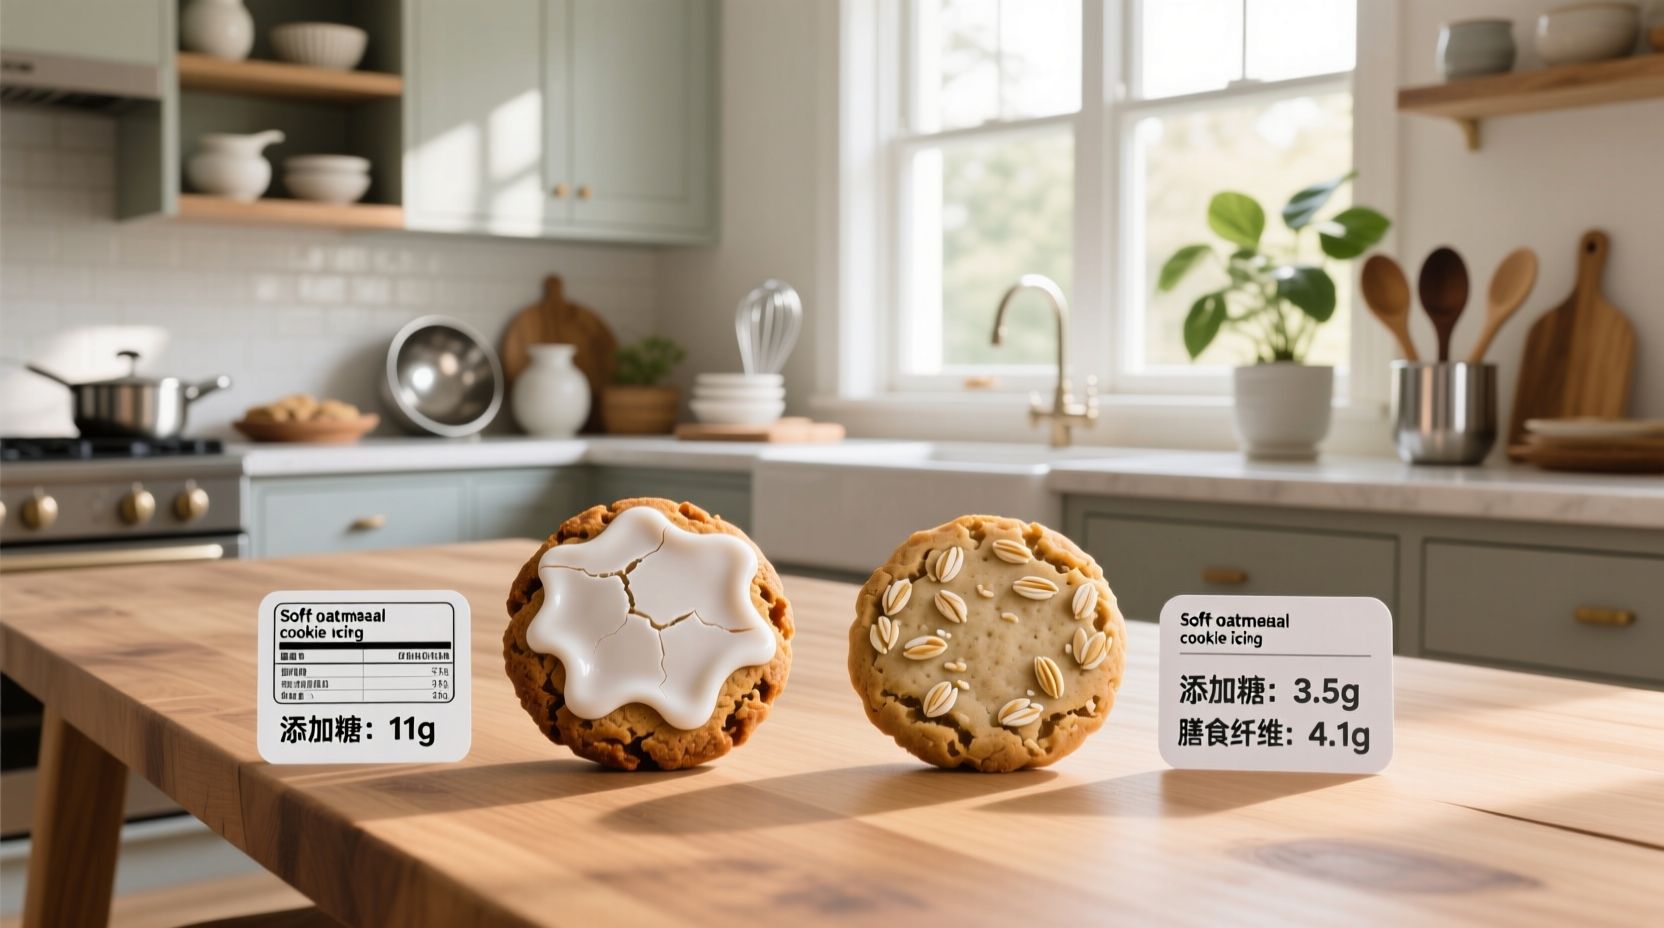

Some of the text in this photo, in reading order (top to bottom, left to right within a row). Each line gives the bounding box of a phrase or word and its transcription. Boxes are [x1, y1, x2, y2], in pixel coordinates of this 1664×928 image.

[279, 625, 327, 639] cookie
[1231, 631, 1263, 648] icing
[1293, 677, 1360, 711] 3.5g
[389, 716, 435, 747] 11g
[1308, 721, 1370, 755] 4.1g
